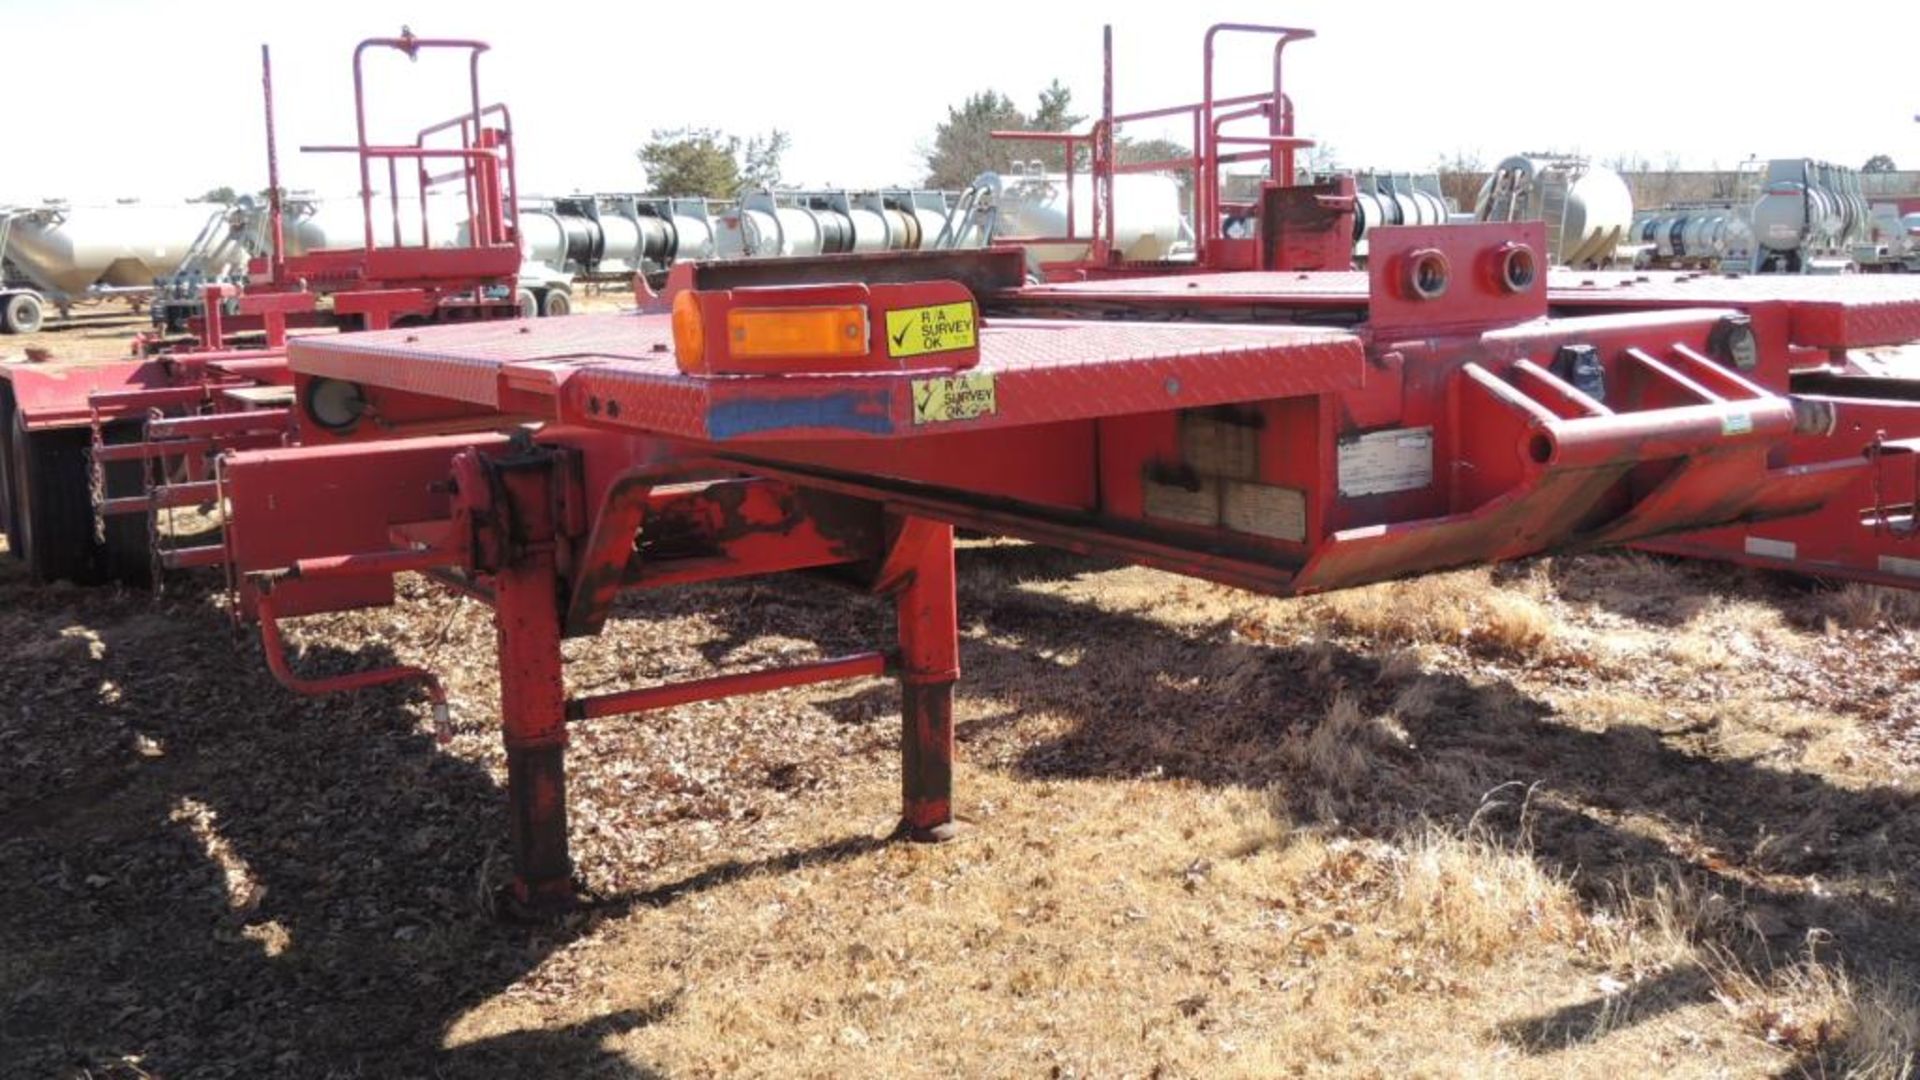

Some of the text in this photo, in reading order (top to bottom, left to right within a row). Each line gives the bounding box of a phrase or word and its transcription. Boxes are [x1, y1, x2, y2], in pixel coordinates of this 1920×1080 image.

[922, 319, 972, 336] SURVEY
[923, 336, 942, 350] OK
[944, 388, 993, 406] SURVEY
